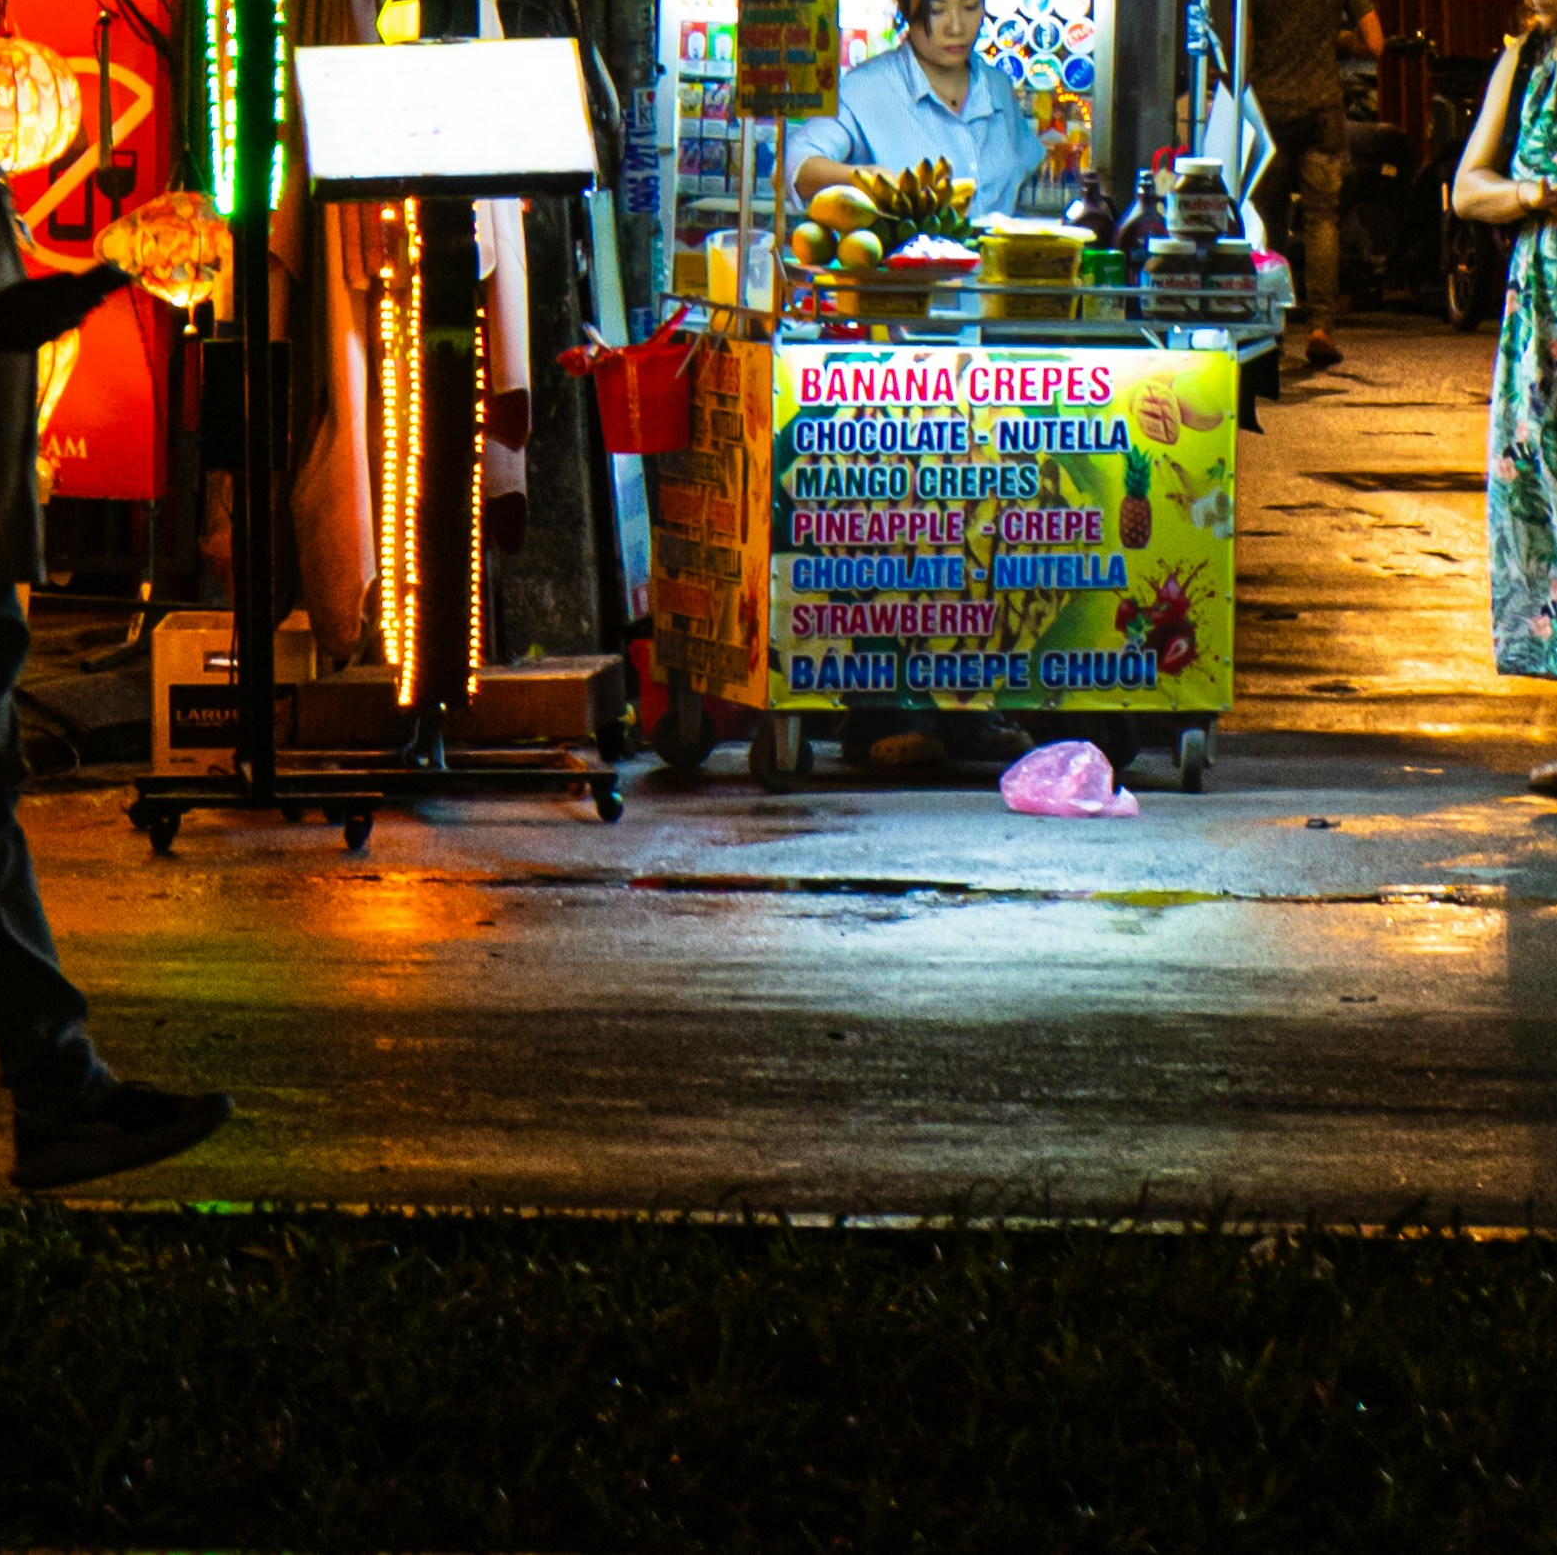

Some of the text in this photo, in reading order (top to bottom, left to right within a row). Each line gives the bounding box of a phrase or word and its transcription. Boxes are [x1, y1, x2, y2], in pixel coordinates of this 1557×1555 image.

[801, 366, 1112, 403] BANANA CREPES
[794, 421, 967, 453] CHOCOLATE
[999, 420, 1130, 452] NUTELLA
[794, 466, 1039, 499] MANGO CREPES
[793, 511, 964, 544] PINEAPPLE
[1004, 510, 1102, 543] CREPE
[792, 557, 964, 590] CHOCOLATE
[994, 555, 1128, 589] NUTELLA
[792, 603, 996, 635] STRAWBERRY
[790, 647, 896, 691] BÁNH
[907, 653, 1029, 690] CREPE
